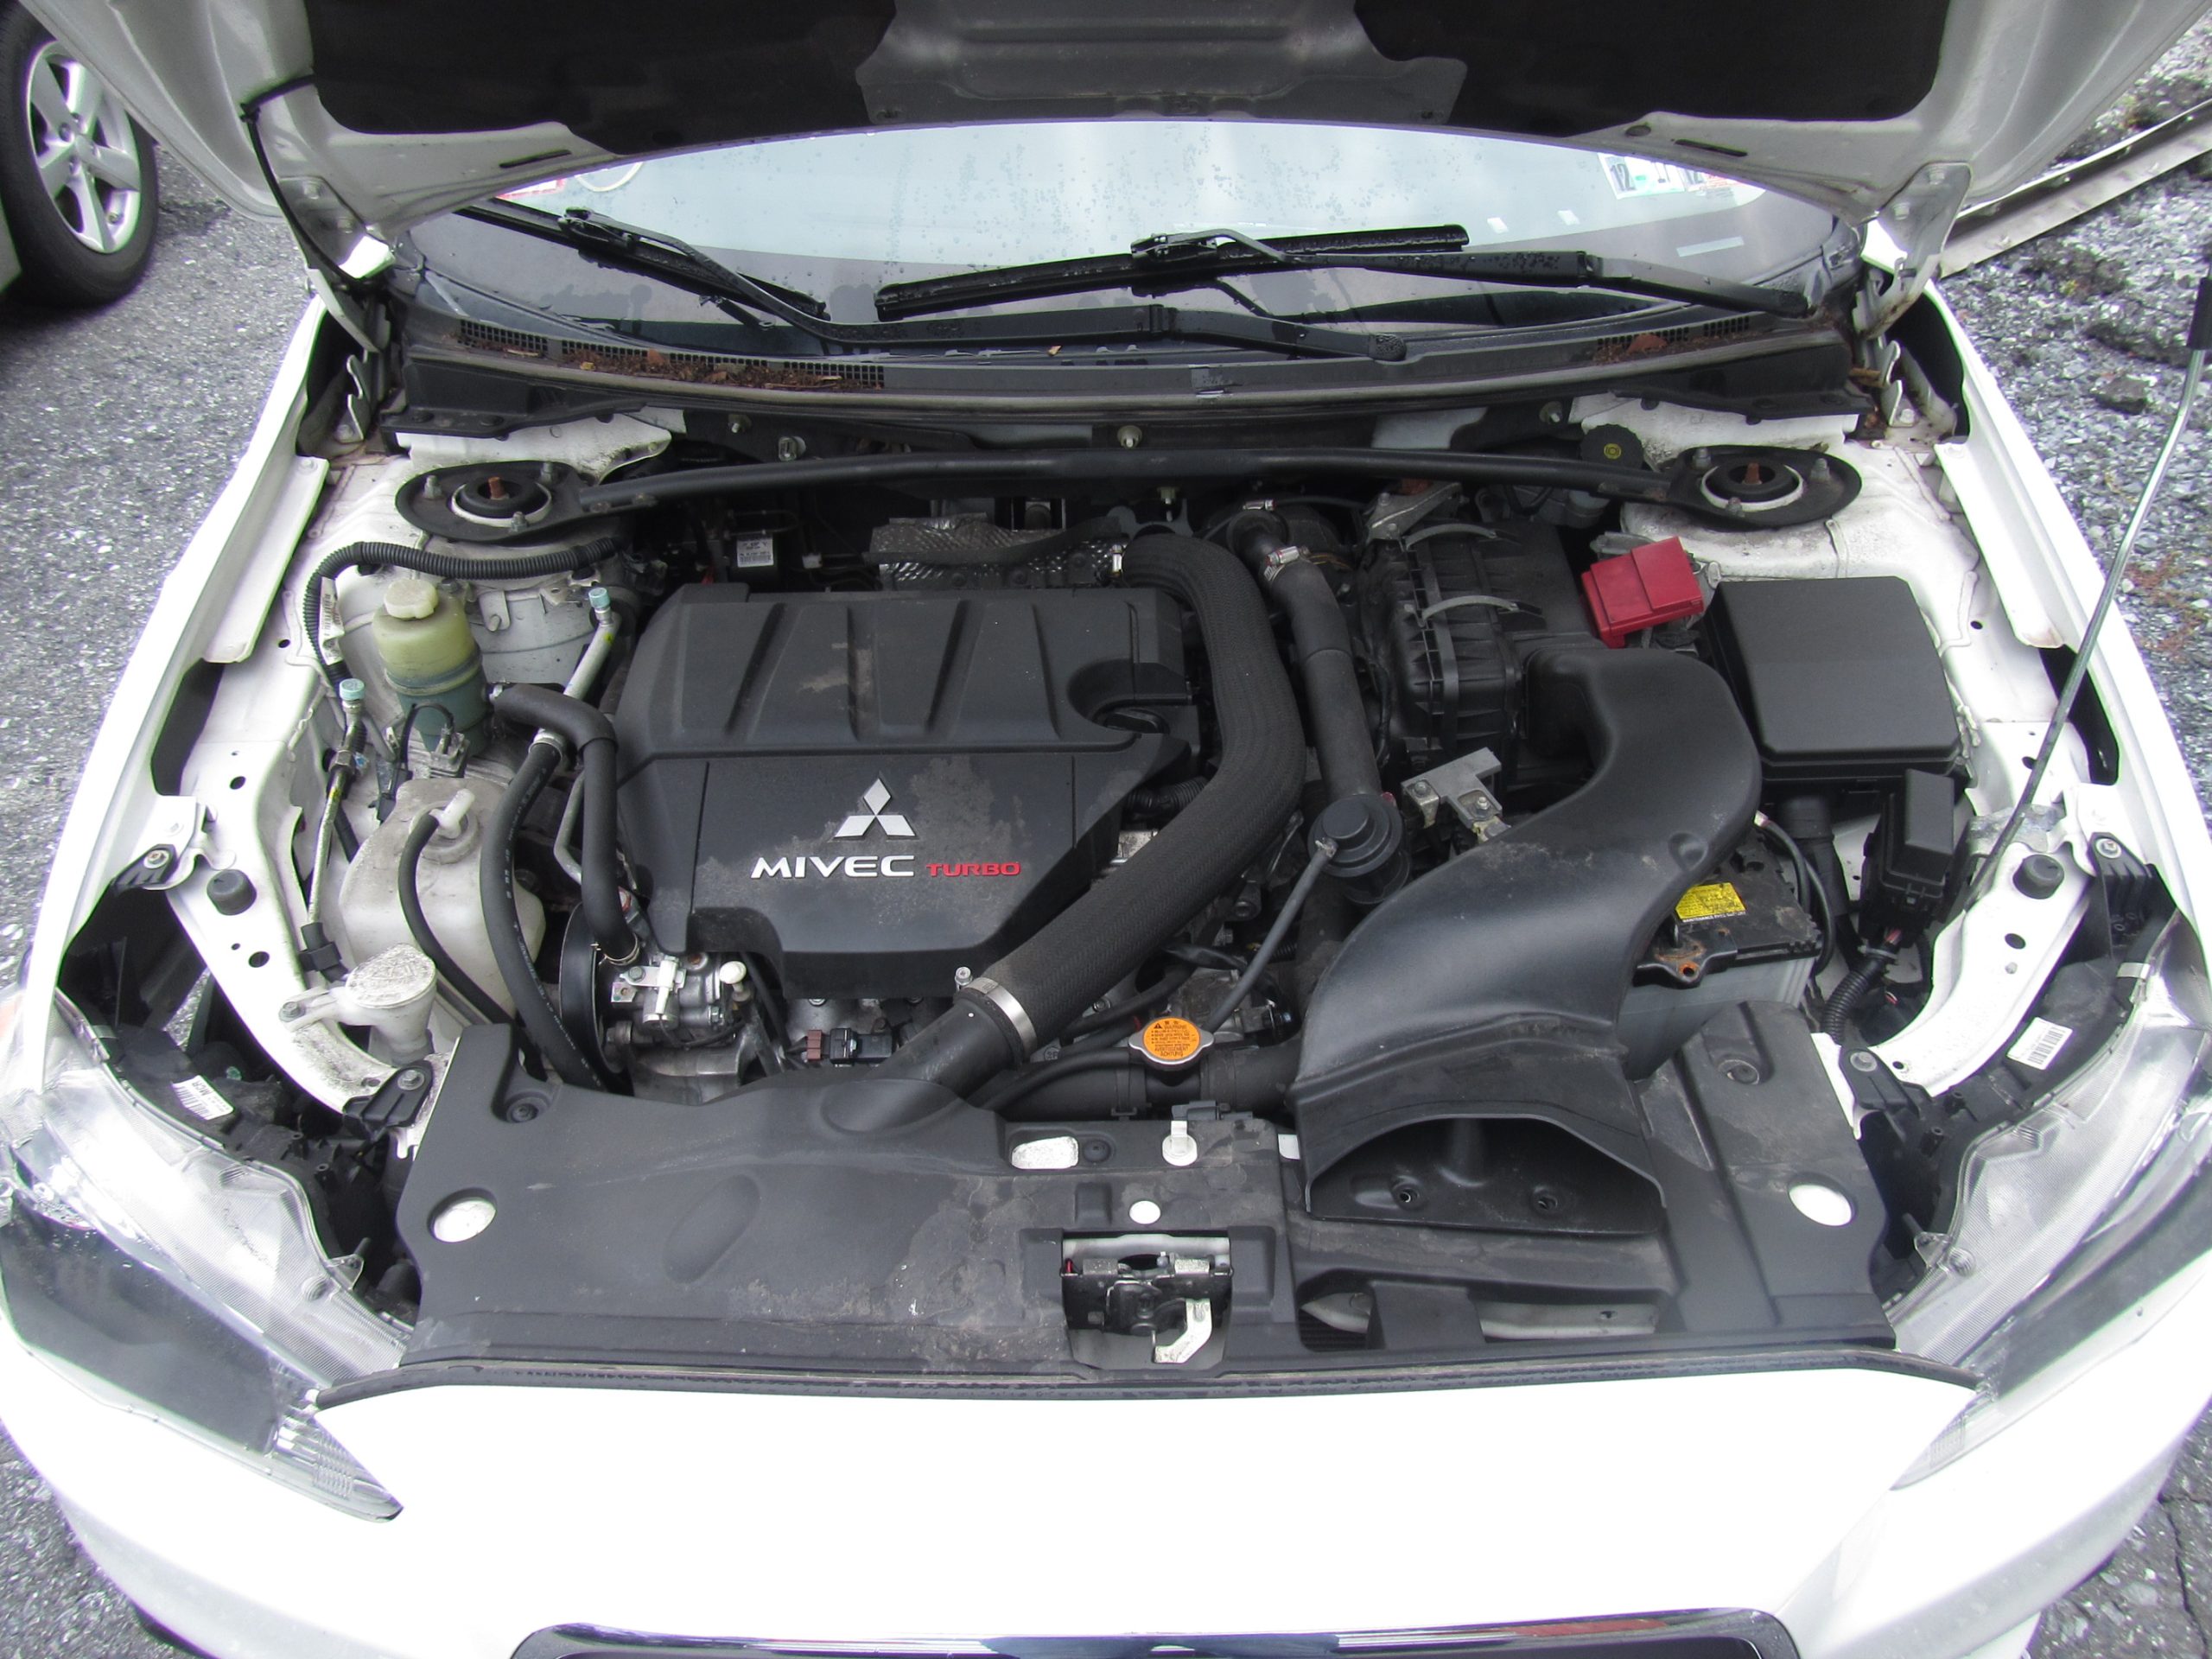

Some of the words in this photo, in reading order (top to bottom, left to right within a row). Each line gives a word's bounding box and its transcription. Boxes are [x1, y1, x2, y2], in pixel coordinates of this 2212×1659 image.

[1610, 162, 1637, 192] 12
[750, 855, 914, 879] MIVEC
[926, 861, 1020, 877] TURBO
